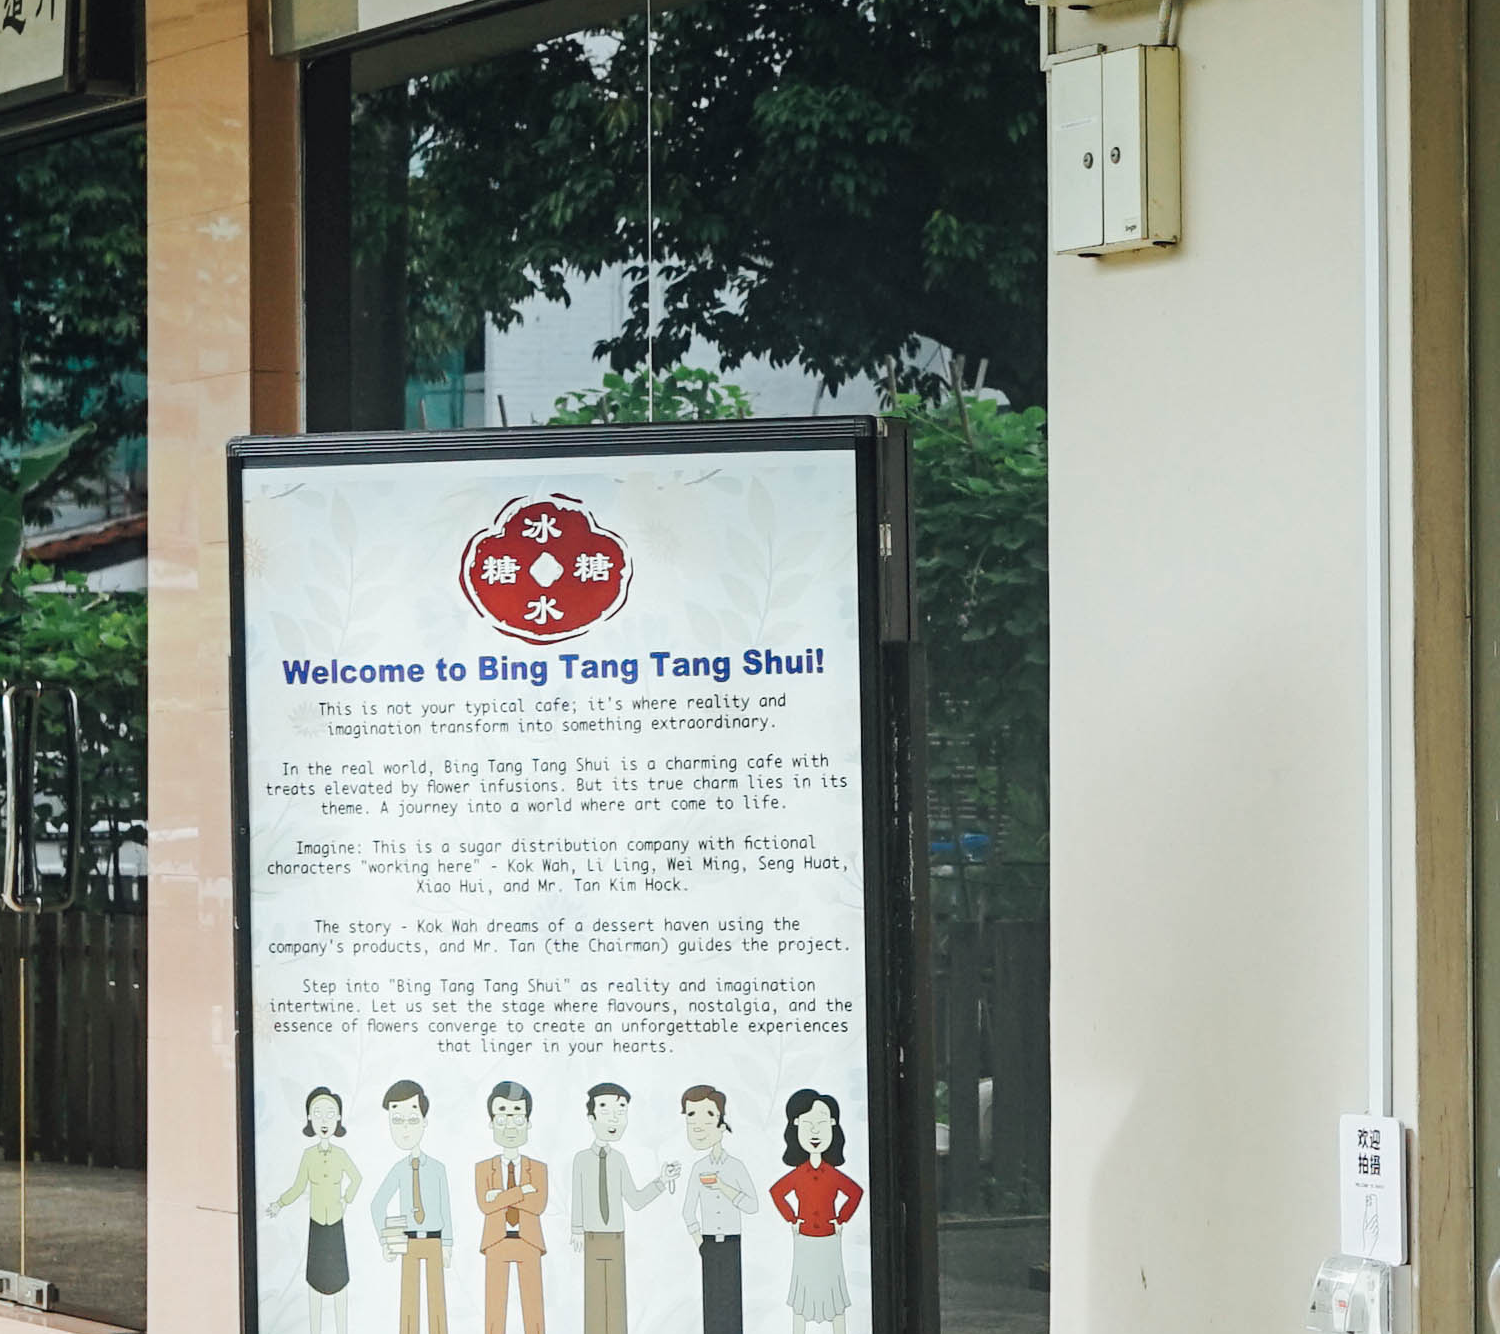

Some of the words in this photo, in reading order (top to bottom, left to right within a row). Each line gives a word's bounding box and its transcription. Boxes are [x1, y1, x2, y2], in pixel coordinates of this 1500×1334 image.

[522, 514, 562, 544] 冰
[481, 555, 521, 585] 糖
[573, 553, 614, 583] 糖
[524, 595, 564, 625] 水
[282, 659, 425, 685] Welcome
[436, 658, 466, 682] to
[479, 656, 547, 686] Bing
[559, 654, 638, 684] Tang
[650, 652, 730, 682] Tang
[743, 648, 823, 675] Shui!
[318, 702, 353, 715] This
[361, 701, 378, 715] is
[386, 702, 412, 714] not
[421, 704, 456, 717] your
[465, 698, 525, 717] typical
[534, 697, 577, 714] cafe;
[587, 697, 623, 711] it's
[631, 696, 677, 710] where
[687, 694, 750, 711] reality
[758, 692, 787, 707] and
[327, 721, 422, 739] imagination
[429, 719, 509, 734] transform
[517, 719, 553, 733] into
[562, 717, 642, 734] something
[651, 714, 776, 731] extraordinary.
[282, 762, 299, 776] In
[307, 762, 333, 775] the
[341, 761, 374, 775] real
[383, 760, 434, 776] world,
[444, 760, 479, 777] Bing
[487, 759, 523, 776] Tang
[531, 758, 567, 775] Tang
[575, 757, 610, 771] Shui
[620, 757, 638, 770] is
[646, 760, 656, 770] a
[665, 755, 738, 773] charming
[746, 754, 783, 768] cafe
[791, 753, 829, 767] with
[320, 801, 370, 815] theme.
[380, 801, 389, 813] A
[398, 800, 458, 817] journey
[467, 799, 502, 813] into
[510, 802, 519, 812] a
[527, 798, 572, 812] world
[580, 798, 626, 811] where
[634, 798, 661, 811] art
[670, 799, 707, 810] come
[715, 797, 734, 810] to
[742, 794, 786, 809] life.
[267, 857, 352, 874] characters
[361, 860, 429, 876] "working
[437, 859, 480, 873] here"
[507, 859, 533, 872] Kok
[541, 859, 576, 875] Wah,
[587, 858, 604, 872] Li
[614, 858, 656, 875] Ling,
[666, 857, 693, 871] Wei
[702, 856, 747, 874] Ming,
[758, 856, 795, 873] Seng
[803, 856, 848, 872] Huat,
[416, 879, 451, 893] Xiao
[459, 879, 493, 895] Hui,
[503, 879, 530, 892] and
[537, 879, 563, 892] Mr.
[573, 878, 601, 891] Tan
[609, 878, 637, 891] Kim
[645, 877, 688, 891] Hock.
[268, 939, 344, 956] company's
[353, 939, 429, 955] products,
[439, 939, 465, 953] and
[473, 939, 498, 952] Mr.
[508, 939, 535, 952] Tan
[544, 938, 580, 955] (the
[588, 937, 669, 954] Chairman)
[677, 937, 733, 955] guides
[741, 937, 769, 951] the
[778, 937, 850, 954] project.
[302, 979, 337, 995] Step
[345, 979, 380, 992] into
[389, 979, 431, 996] "Bing
[439, 979, 475, 996] Tang
[483, 979, 519, 996] Tang
[527, 979, 570, 992] Shui"
[580, 982, 598, 992] as
[607, 978, 670, 996] reality
[678, 979, 706, 992] and
[715, 978, 816, 995] imagination
[273, 1022, 333, 1032] essence
[341, 1018, 359, 1032] of
[367, 1018, 419, 1032] flowers
[428, 1022, 497, 1036] converge
[506, 1020, 524, 1032] to
[533, 1020, 586, 1032] create
[594, 1022, 613, 1032] an
[621, 1018, 739, 1036] unforgettable
[748, 1018, 849, 1035] experiences
[436, 1039, 471, 1052] that
[480, 1038, 533, 1056] linger
[542, 1039, 560, 1052] in
[568, 1043, 604, 1056] your
[612, 1039, 674, 1053] hearts.
[1357, 1128, 1381, 1151] 欢迎
[1357, 1155, 1381, 1176] 拍摄
